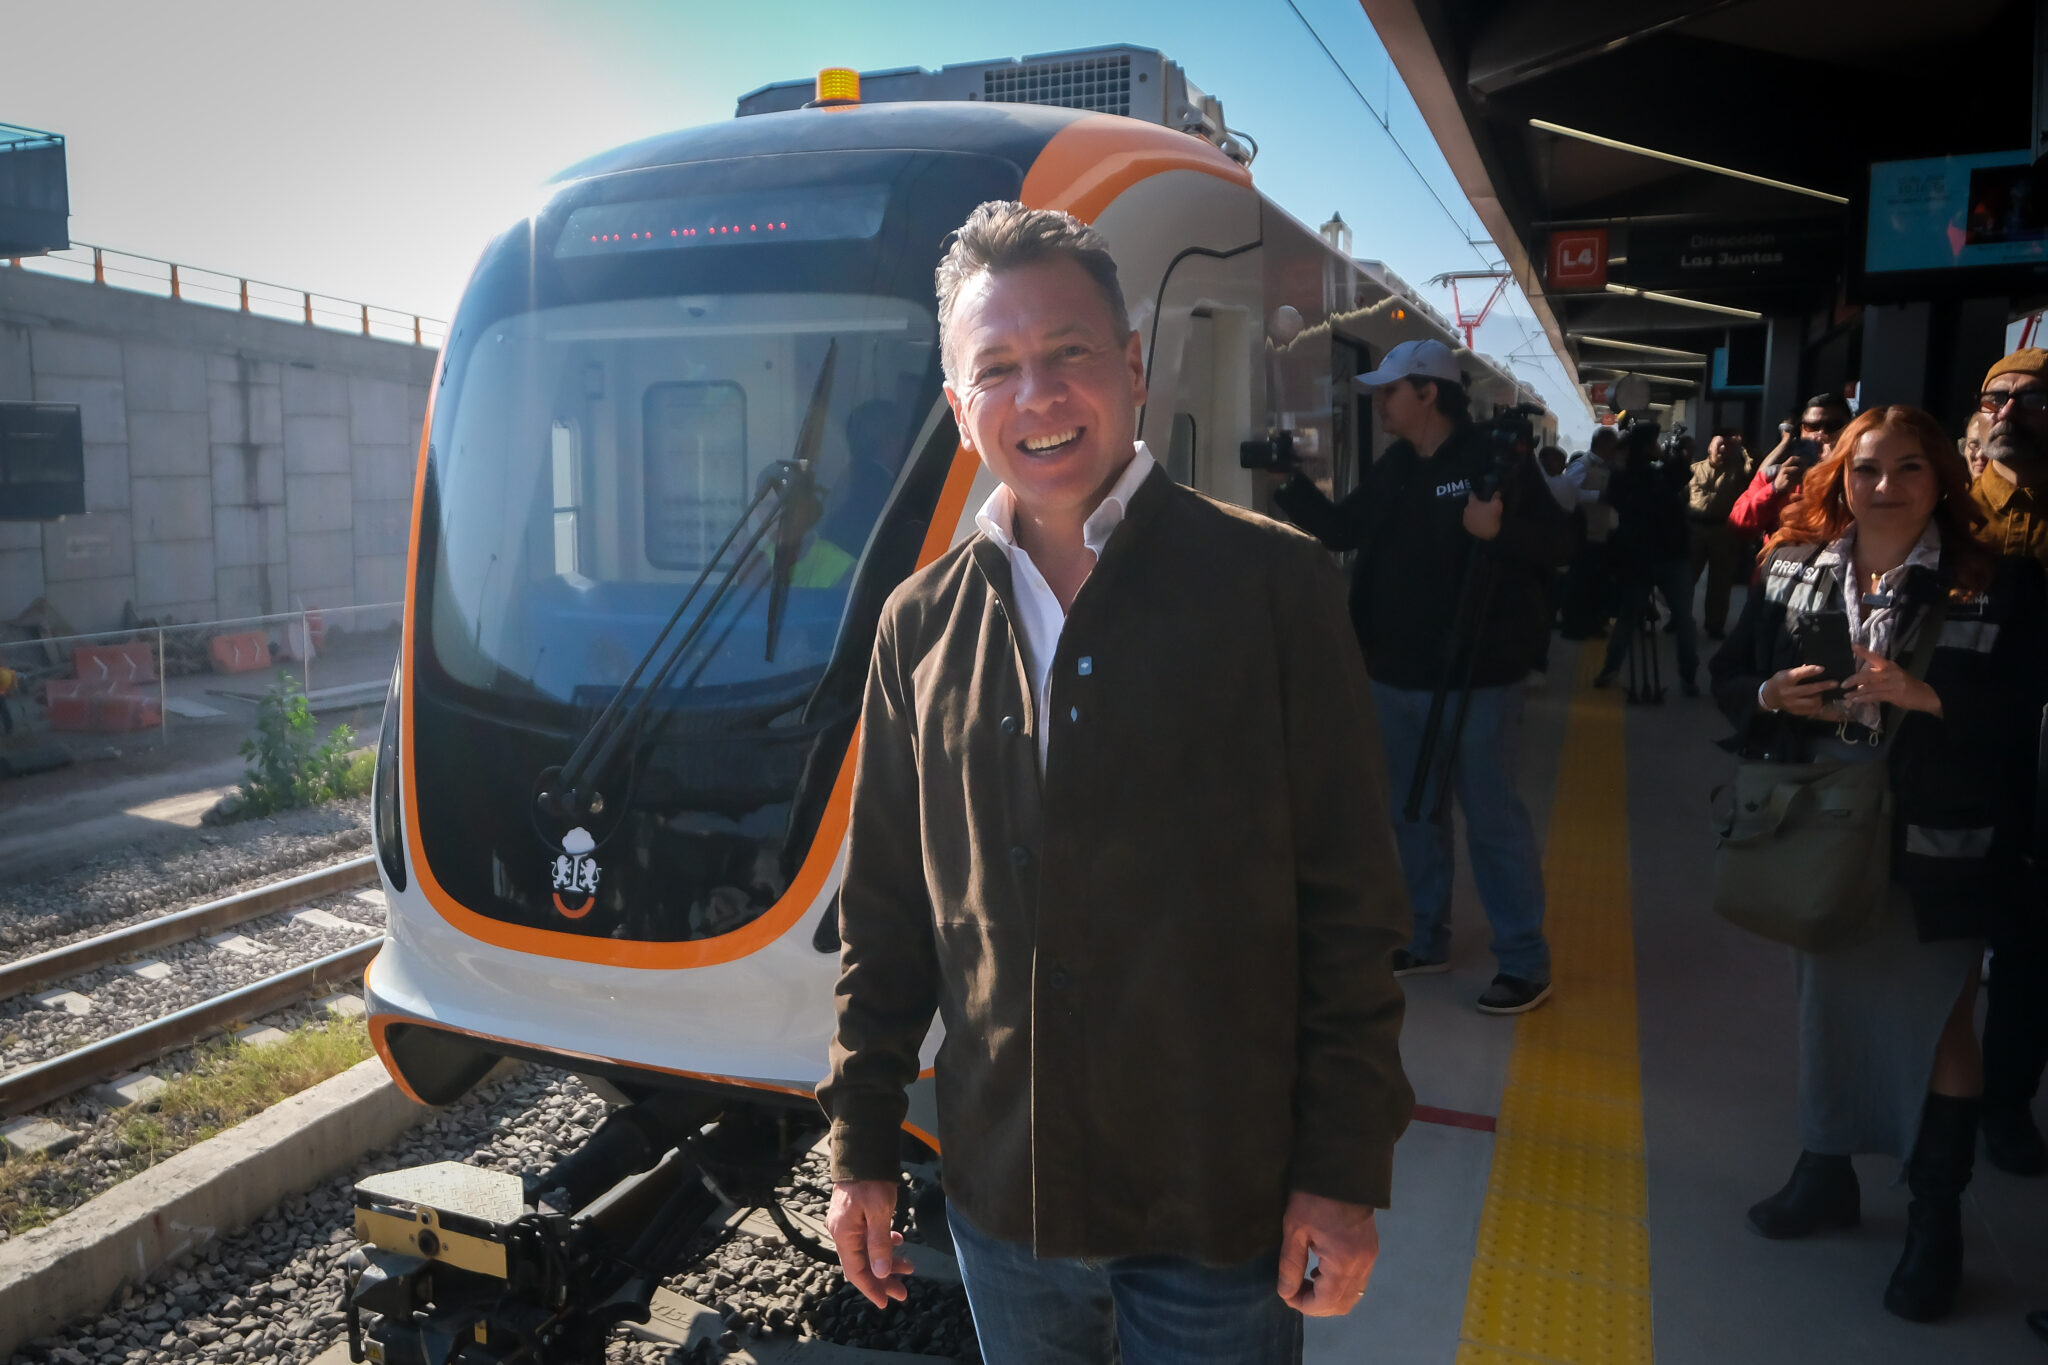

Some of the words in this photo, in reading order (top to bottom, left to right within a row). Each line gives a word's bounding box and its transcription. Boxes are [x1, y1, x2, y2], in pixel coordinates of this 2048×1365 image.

[1563, 248, 1593, 267] L4
[1680, 253, 1713, 267] Las
[1718, 250, 1784, 265] Juntas
[1770, 559, 1820, 584] PRENSA
